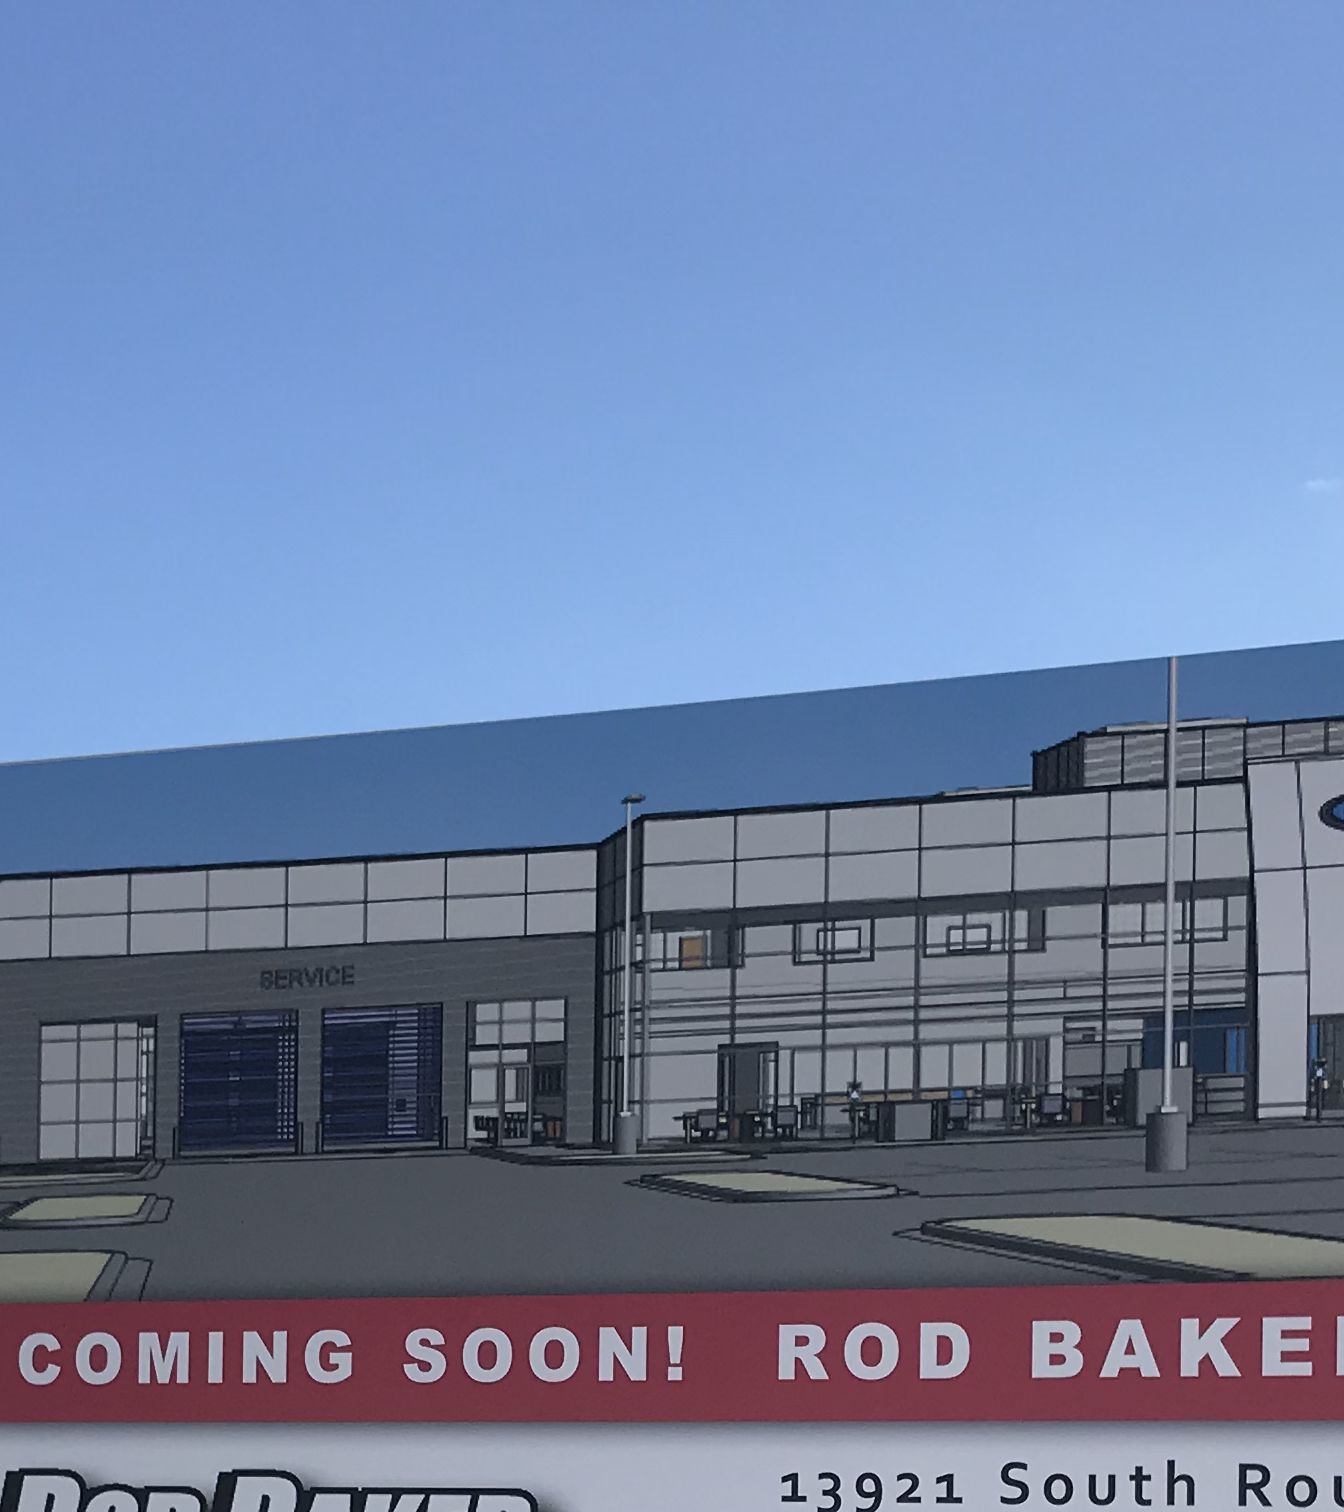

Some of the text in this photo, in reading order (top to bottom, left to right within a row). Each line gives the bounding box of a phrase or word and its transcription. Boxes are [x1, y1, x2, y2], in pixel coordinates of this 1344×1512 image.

[260, 964, 355, 990] SERVICE
[19, 1330, 352, 1385] COMING
[404, 1326, 683, 1383] SOON!
[778, 1322, 969, 1380] ROD
[1000, 1460, 1194, 1506] South
